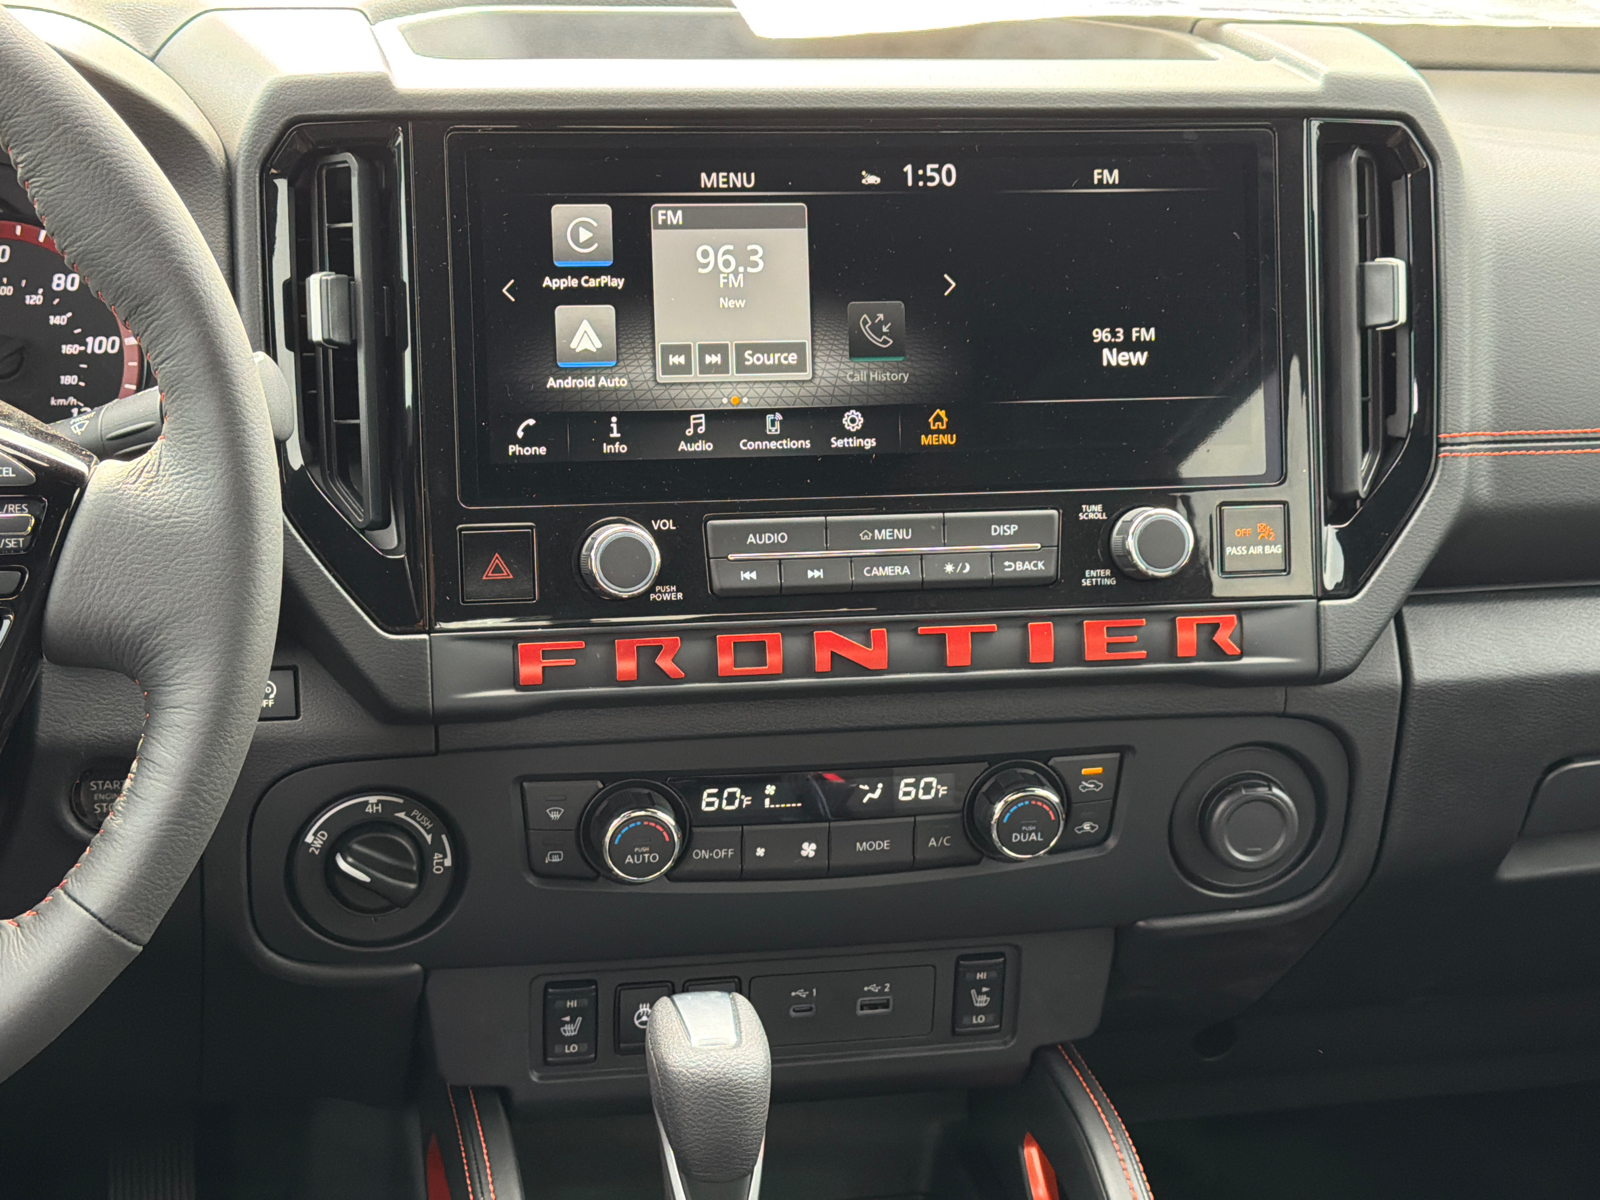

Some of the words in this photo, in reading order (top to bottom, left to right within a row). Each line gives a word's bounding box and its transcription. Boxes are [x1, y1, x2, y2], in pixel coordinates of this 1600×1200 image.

[700, 172, 756, 188] MENU
[902, 163, 957, 188] 1:50
[1093, 169, 1120, 185] FM
[657, 210, 683, 226] FM
[696, 244, 765, 275] 96.3
[51, 273, 80, 292] 80
[542, 276, 579, 290] Apple
[580, 275, 625, 290] CarPlay
[719, 273, 744, 288] FM
[25, 294, 44, 305] 120
[719, 297, 746, 309] New
[48, 315, 68, 326] 140
[1092, 328, 1125, 342] 96.3
[1131, 327, 1155, 342] FM
[61, 344, 80, 355] 160
[85, 336, 120, 354] 100
[743, 350, 798, 366] Source
[1101, 348, 1148, 366] New
[59, 375, 78, 386] 180
[546, 376, 595, 389] Android
[597, 376, 628, 388] Auto
[846, 371, 868, 383] Call
[869, 370, 909, 384] History
[50, 396, 78, 407] km/h
[678, 439, 714, 453] Audio
[739, 437, 811, 451] Connections
[830, 435, 877, 449] Settings
[921, 434, 957, 447] MENU
[508, 443, 547, 457] Phone
[602, 442, 628, 454] Info
[1081, 504, 1103, 512] TUNE
[1078, 511, 1108, 520] SCROLL
[651, 519, 677, 531] VOL
[990, 524, 1019, 537] DISP
[746, 532, 788, 545] AUDIO
[874, 528, 912, 541] MENU
[1234, 528, 1252, 538] OFF
[1226, 546, 1247, 556] PASS
[1248, 546, 1264, 556] AIR
[1264, 545, 1283, 555] BAG
[863, 565, 911, 577] CAMERA
[1015, 560, 1046, 573] BACK
[1085, 569, 1111, 578] ENTER
[655, 584, 677, 593] PUSH
[1081, 577, 1117, 587] SETTING
[649, 592, 684, 602] POWER
[516, 613, 1243, 686] FRONTIER
[262, 699, 275, 708] FF
[364, 803, 382, 814] 4H
[410, 809, 434, 831] PUSH
[308, 830, 329, 856] 2WD
[928, 836, 952, 848] A/C
[1011, 832, 1044, 843] DUAL
[856, 840, 891, 852] MODE
[432, 852, 444, 875] 4LO
[624, 852, 660, 865] AUTO
[976, 971, 988, 981] HI
[884, 983, 890, 993] 2
[566, 999, 578, 1009] HI
[972, 1014, 986, 1025] LO
[564, 1043, 579, 1054] LO
